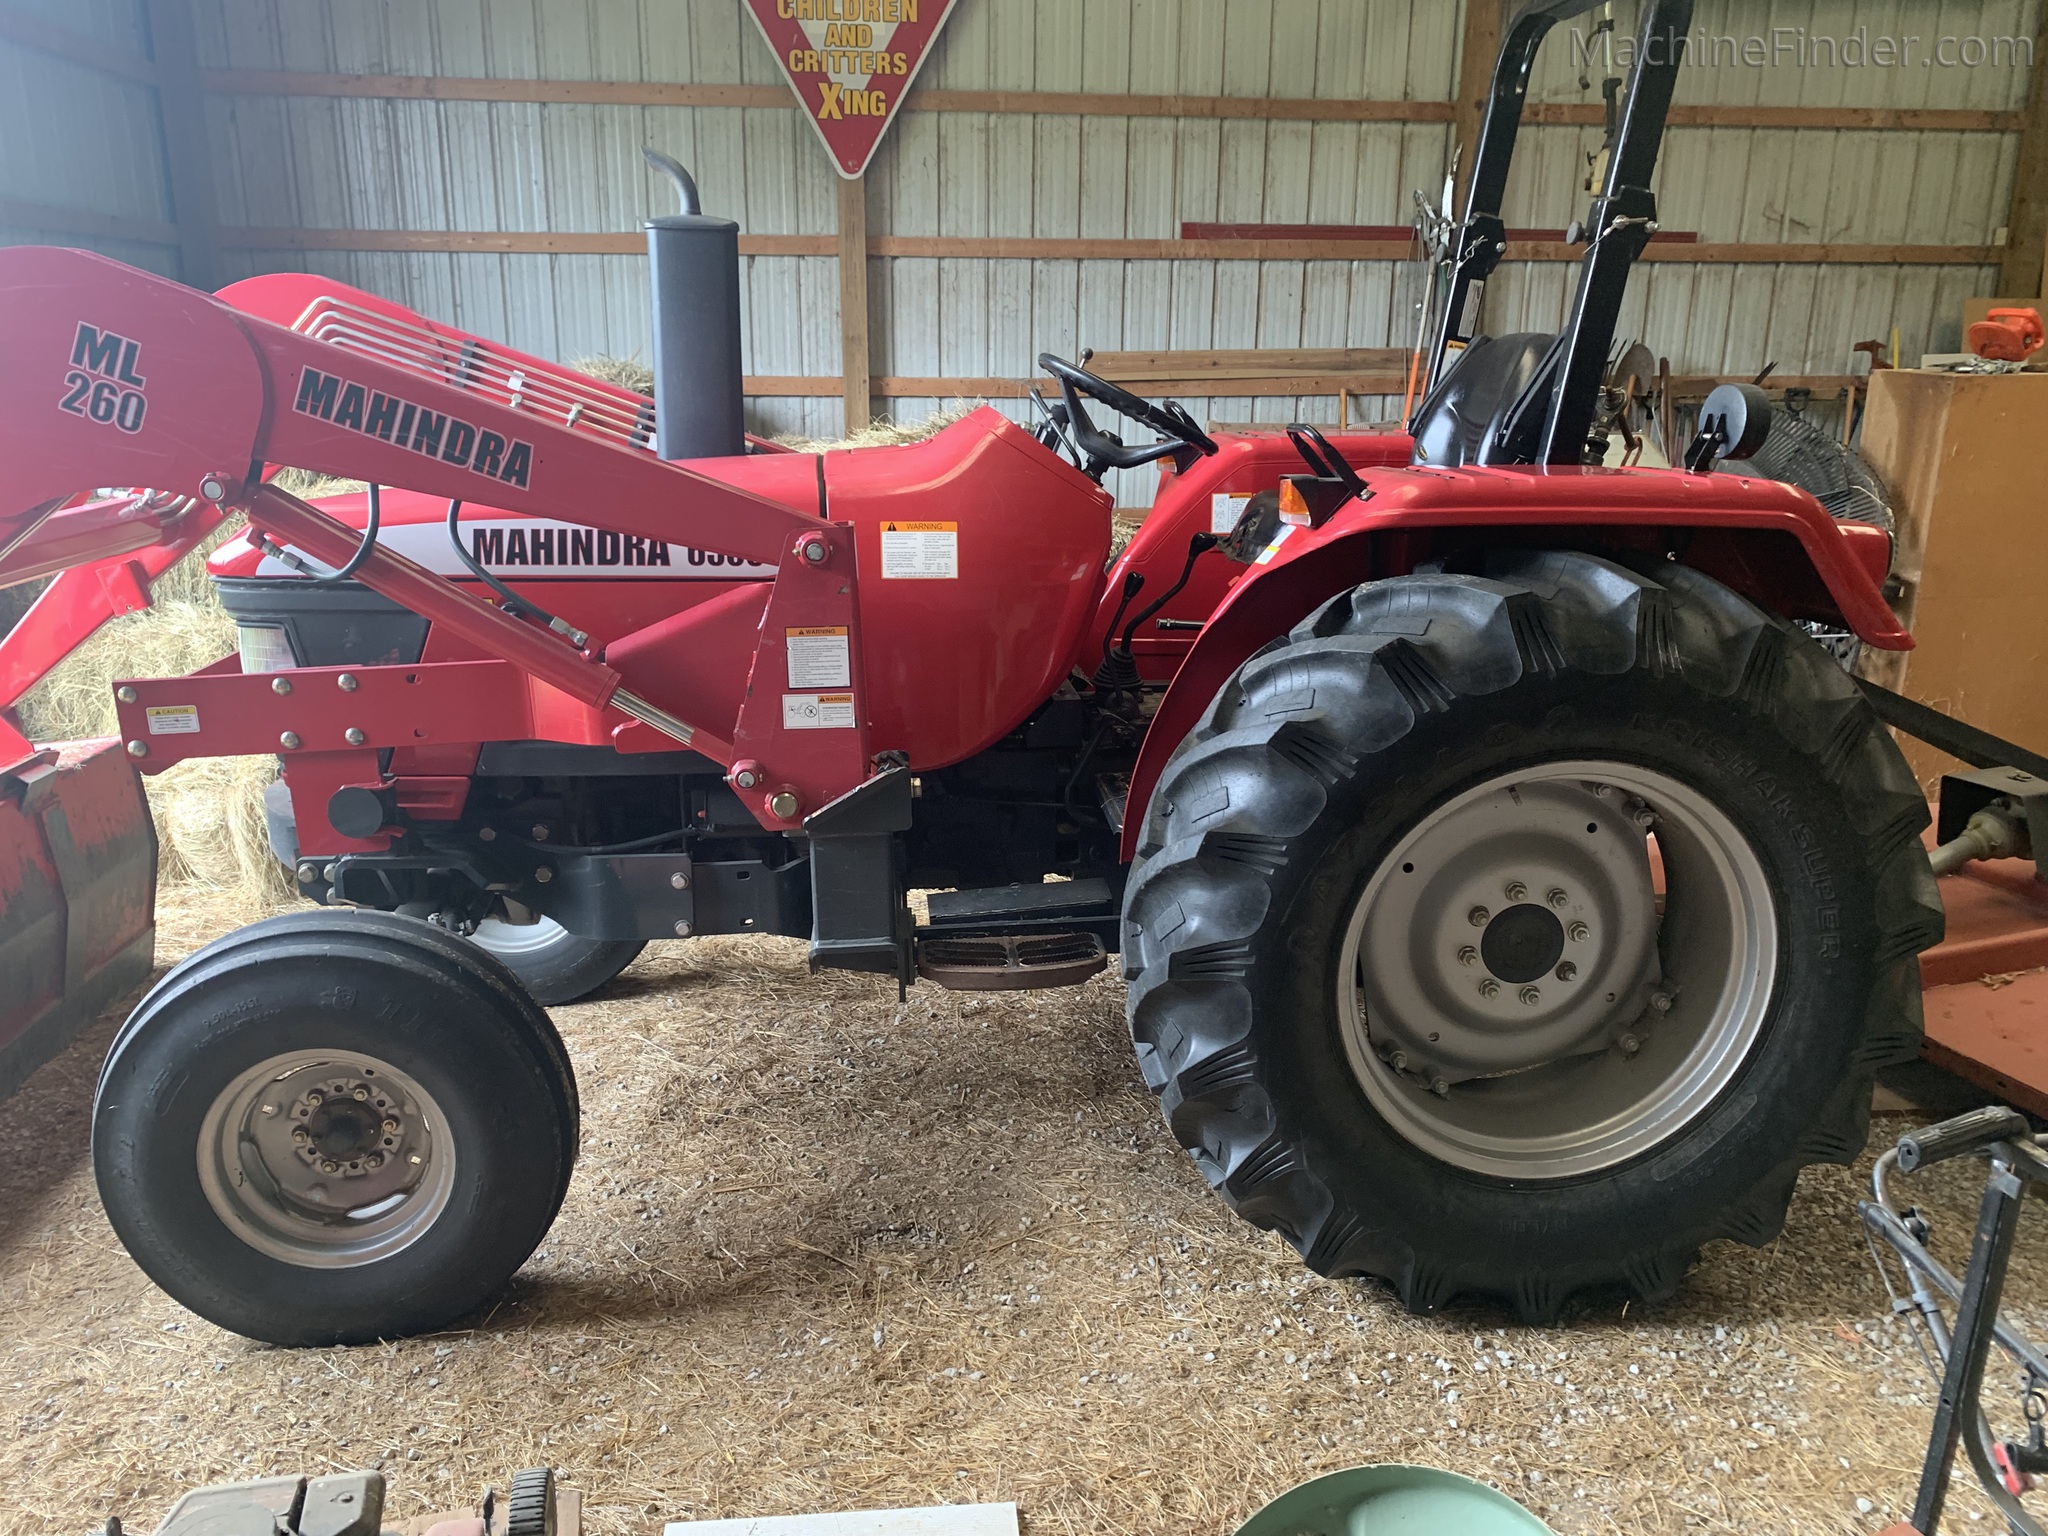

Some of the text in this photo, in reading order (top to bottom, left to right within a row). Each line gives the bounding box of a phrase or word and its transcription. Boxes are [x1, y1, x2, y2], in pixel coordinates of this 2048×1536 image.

[777, 0, 918, 23] CHILDREN
[824, 23, 873, 48] AND
[789, 50, 908, 75] CRITTERS
[70, 321, 146, 390] ML
[58, 370, 148, 434] 260
[293, 365, 534, 491] MAHINDRA
[472, 528, 671, 567] MAHINDRA
